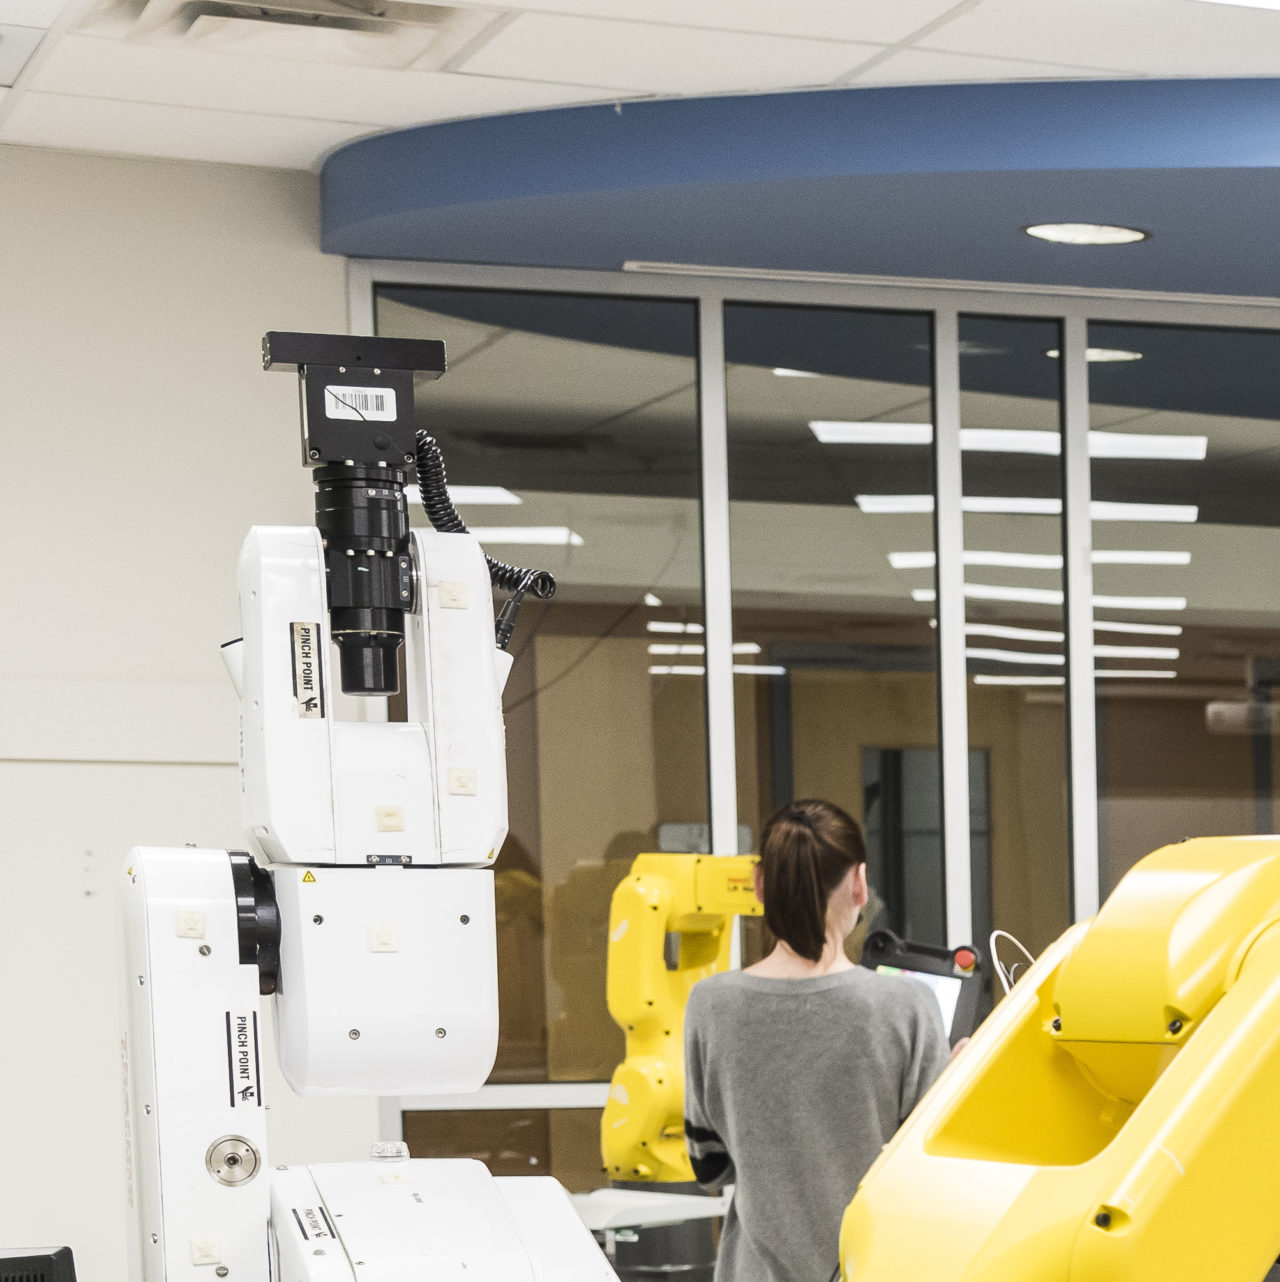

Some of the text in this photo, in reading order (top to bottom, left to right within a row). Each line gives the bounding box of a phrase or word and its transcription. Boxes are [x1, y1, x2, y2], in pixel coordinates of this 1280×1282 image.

[301, 627, 313, 692] PINCH POINT
[237, 1016, 250, 1080] PINCH POINT
